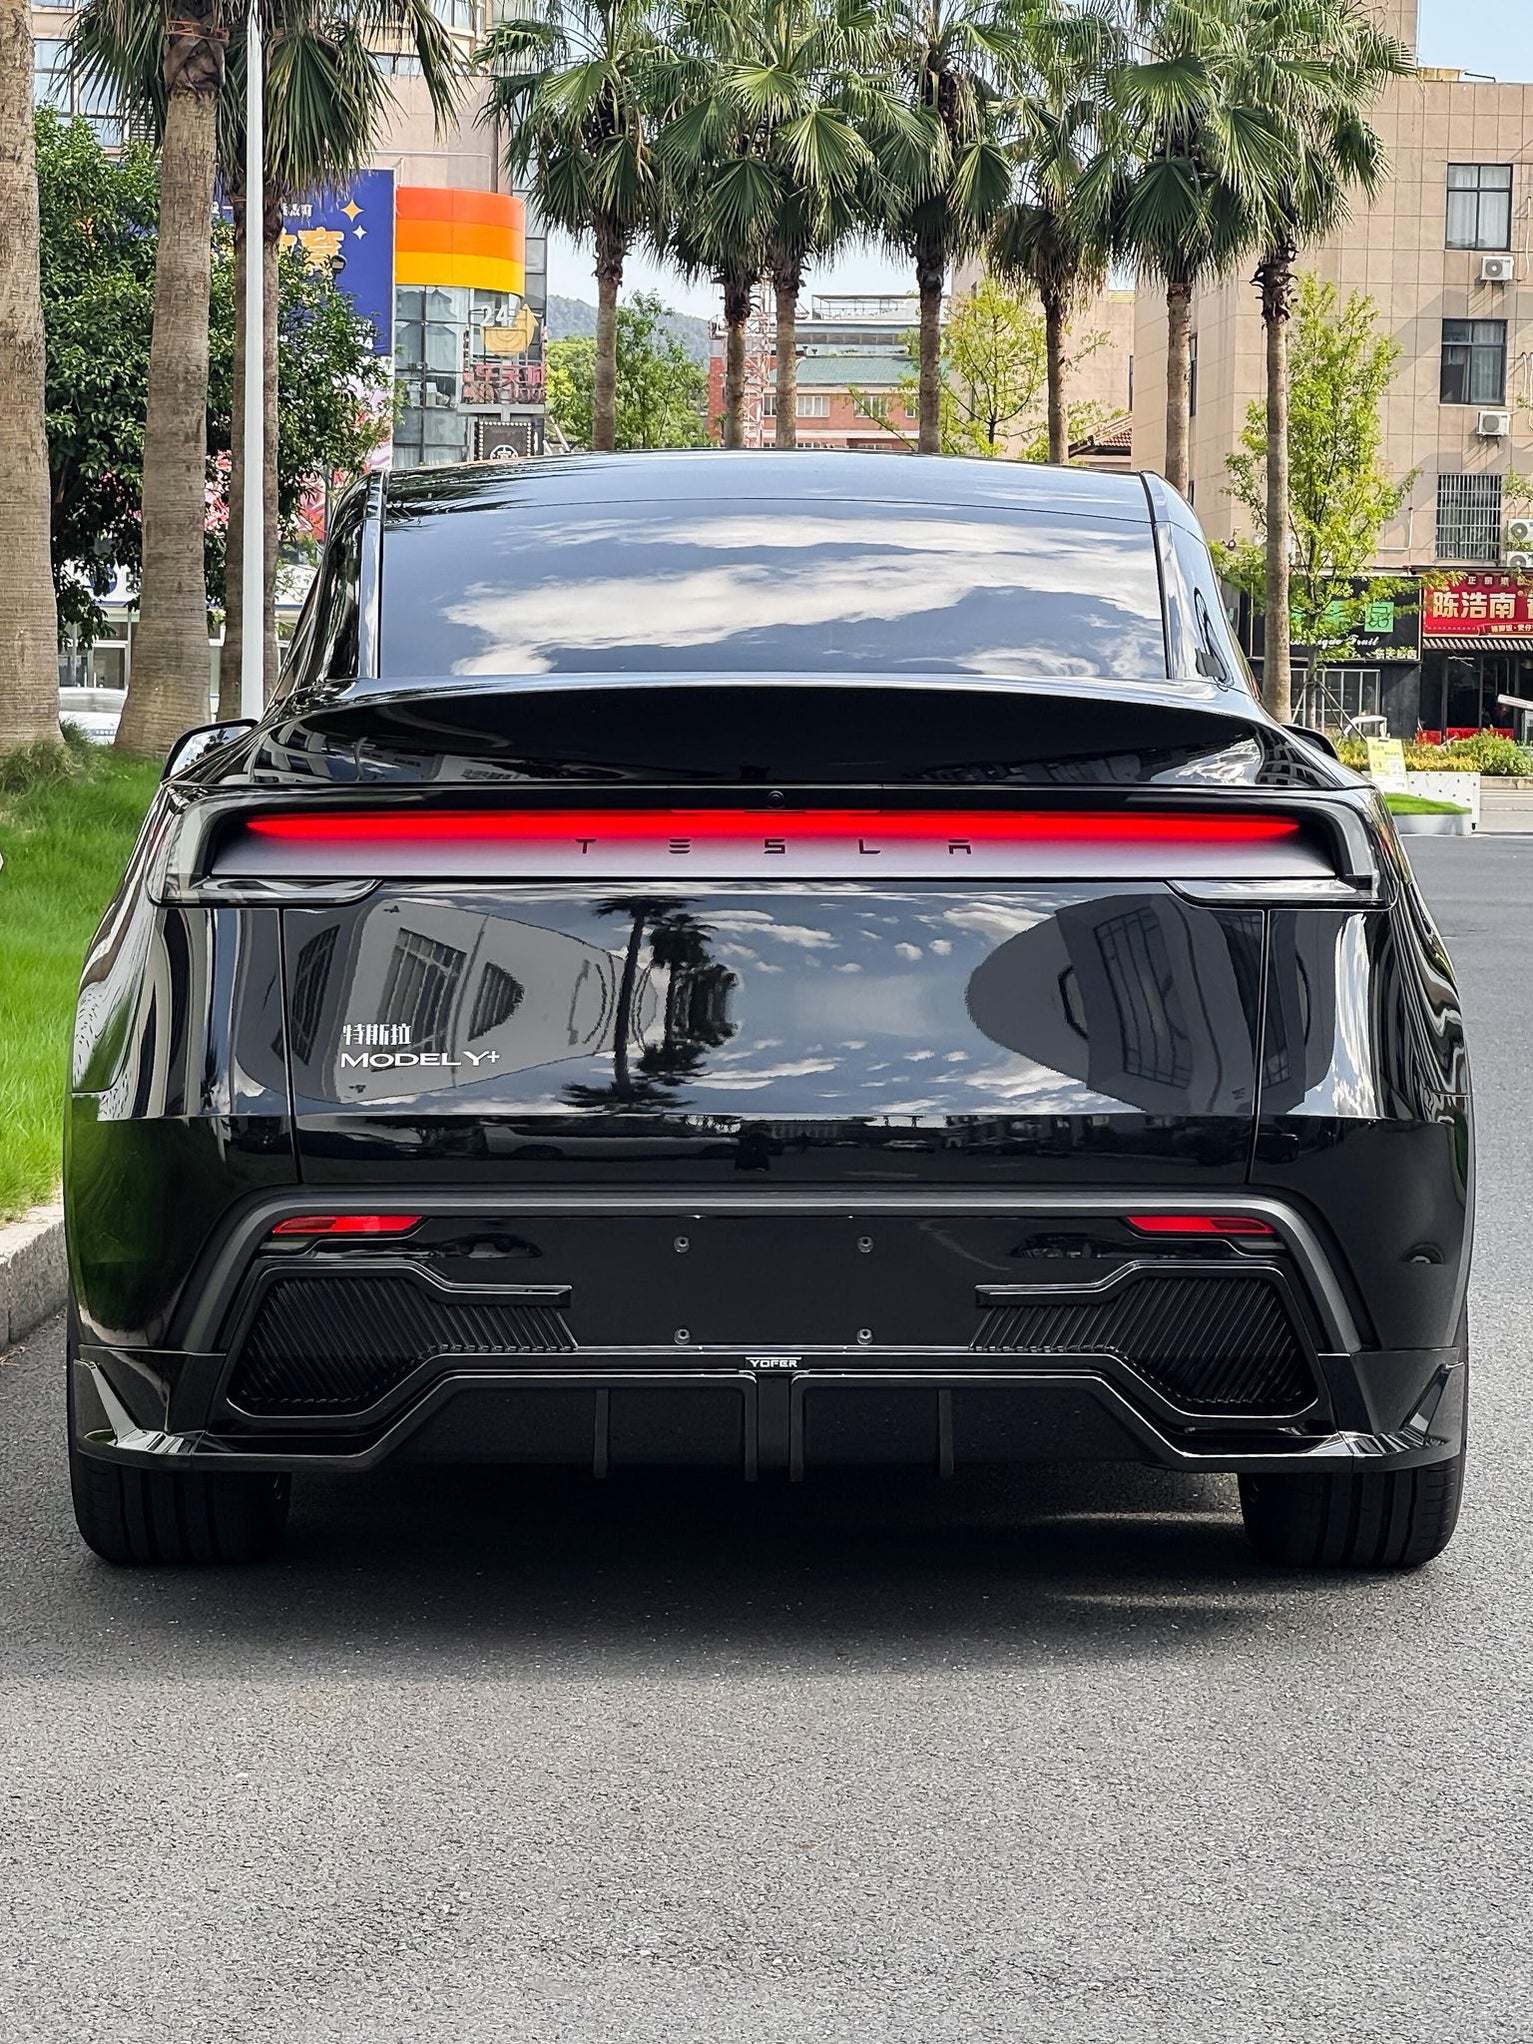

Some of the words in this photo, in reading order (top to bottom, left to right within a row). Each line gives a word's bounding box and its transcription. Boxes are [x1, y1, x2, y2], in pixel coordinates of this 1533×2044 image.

[1433, 592, 1516, 619] 陈浩南
[575, 837, 972, 855] TESLA
[342, 1022, 412, 1046] 特斯拉
[749, 1359, 798, 1368] YOFER
